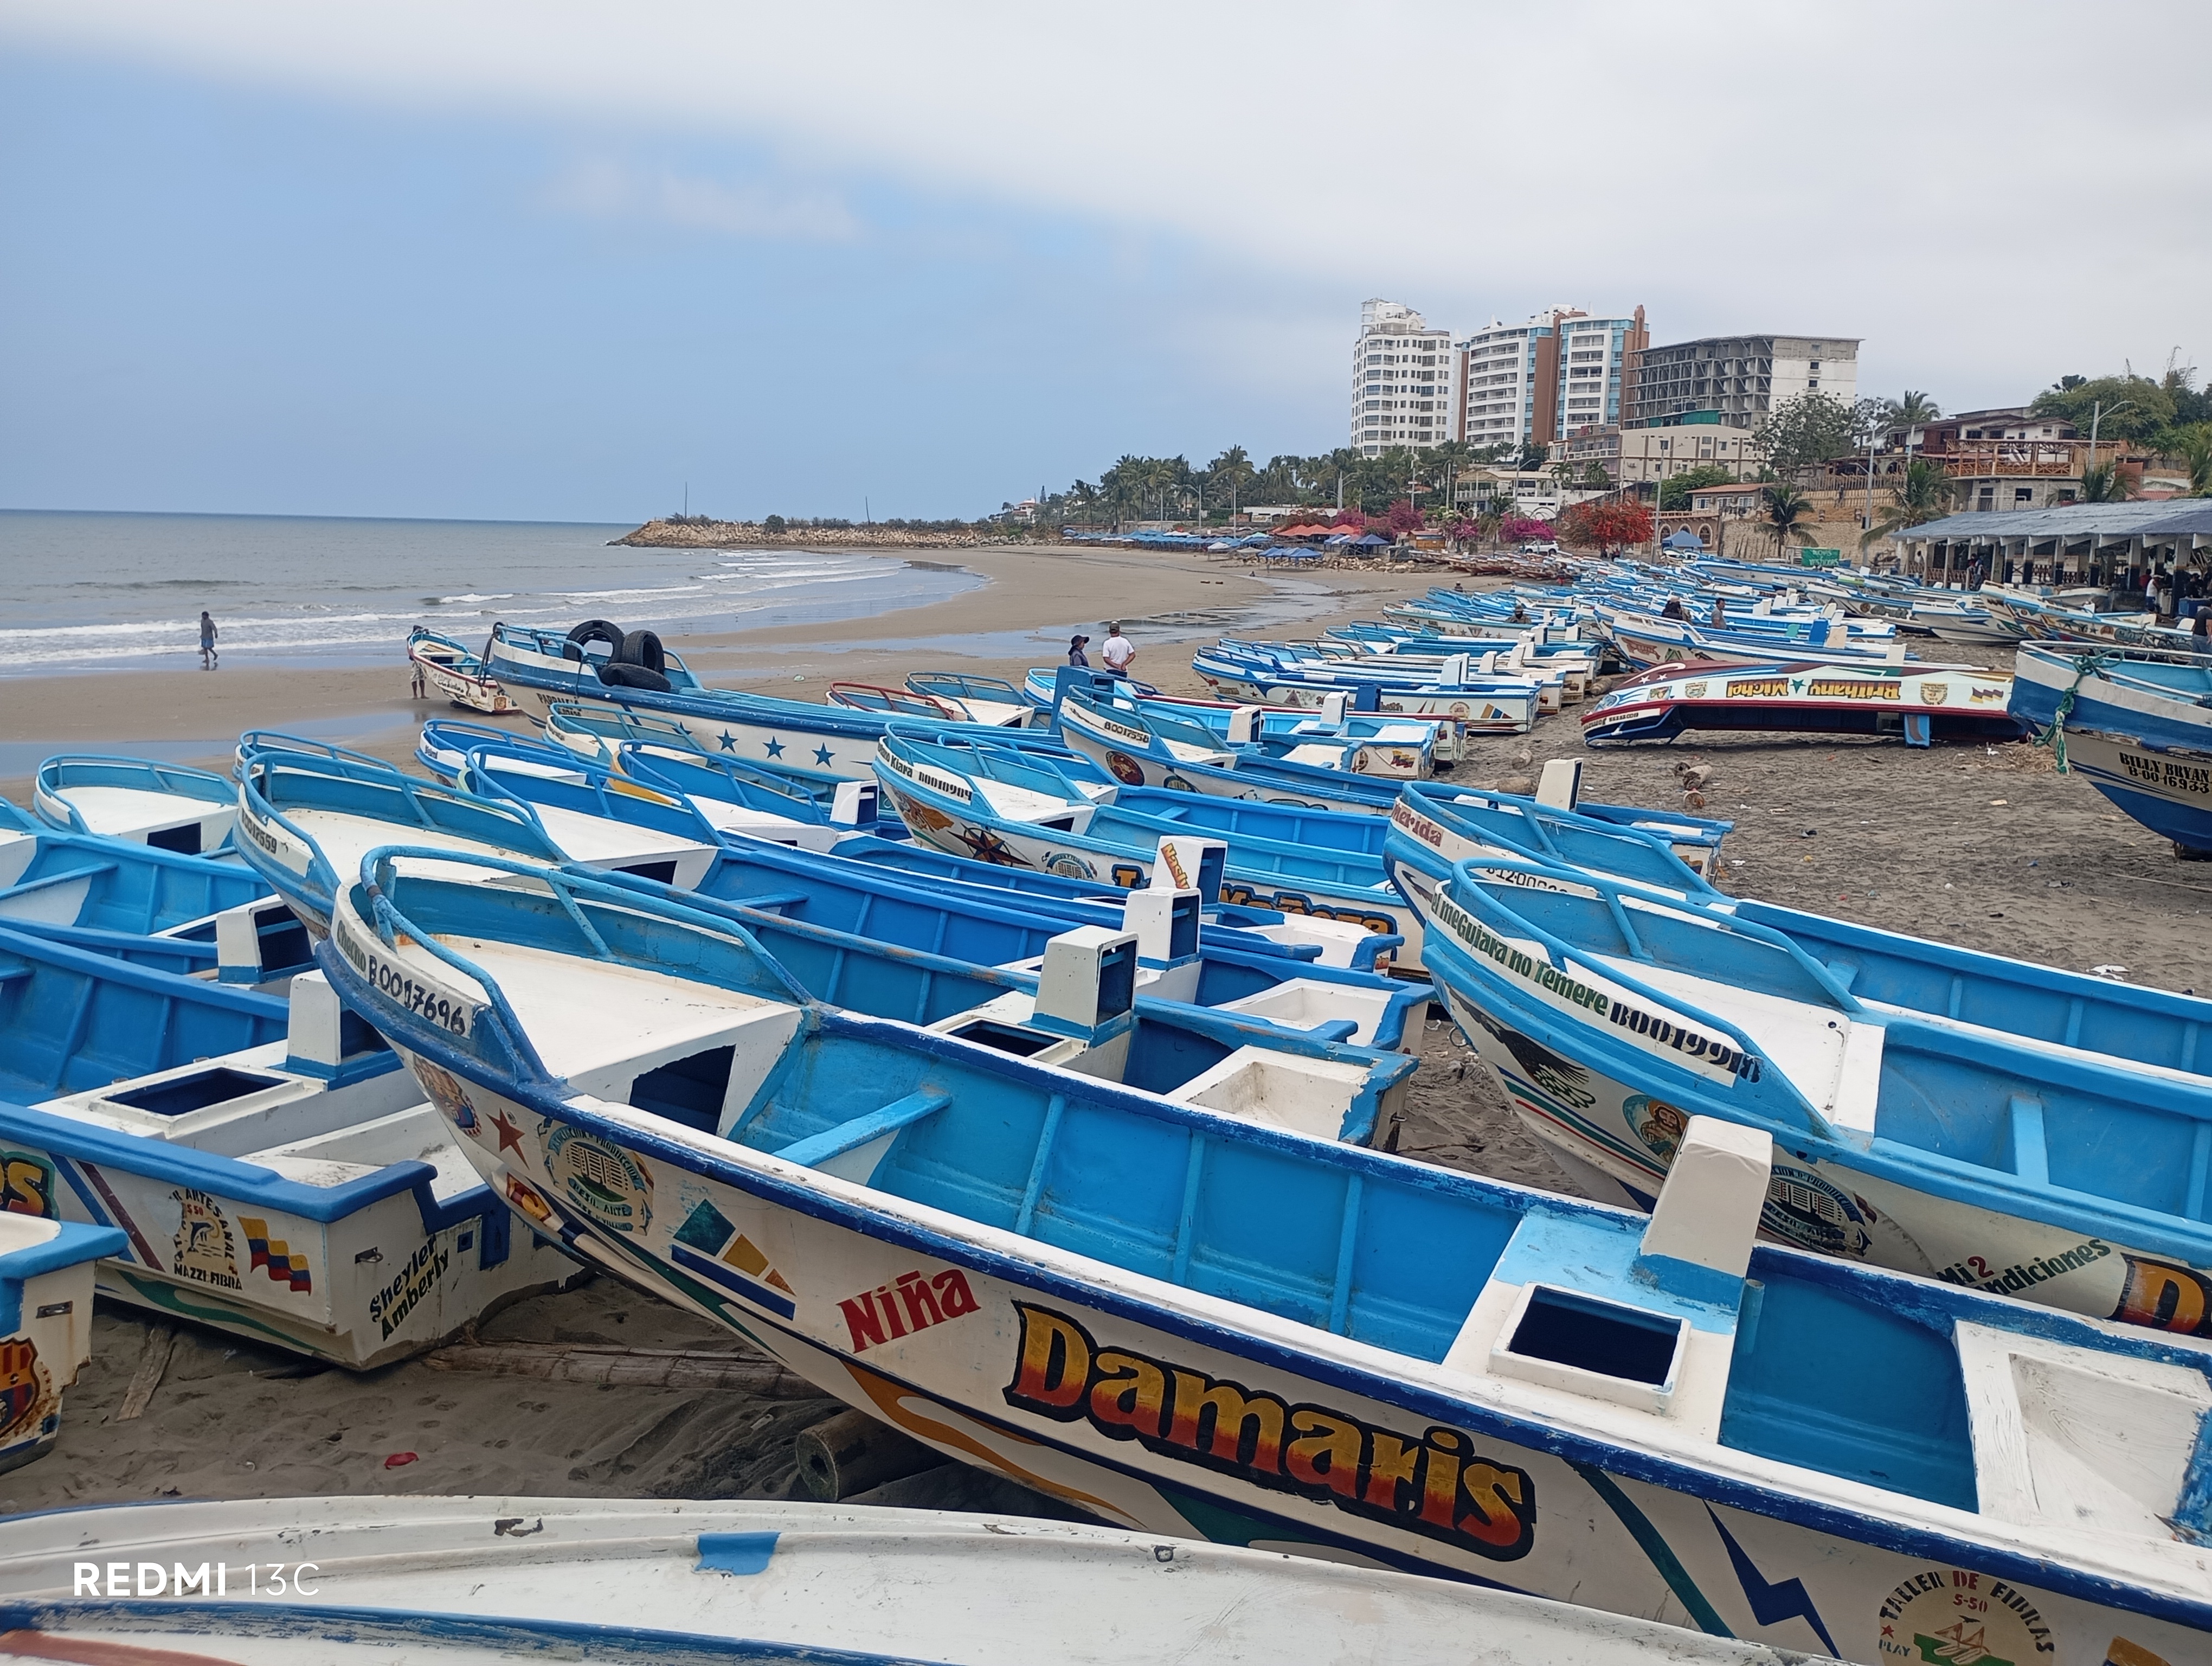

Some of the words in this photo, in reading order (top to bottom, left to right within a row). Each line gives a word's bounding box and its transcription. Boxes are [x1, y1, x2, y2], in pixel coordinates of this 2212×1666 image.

[1726, 678, 1789, 697] Michel
[1104, 721, 1149, 744] B0017558
[2119, 752, 2160, 773] BILLY
[2165, 762, 2209, 783] BRYAN
[1508, 949, 1532, 977] no
[1534, 960, 1609, 1017] Temere
[369, 1234, 437, 1323] Sheyler
[381, 1247, 449, 1342] Amberly
[1967, 1256, 1995, 1278] 2
[1975, 1239, 2111, 1295] ndiciones
[835, 1268, 982, 1354] Niña
[1002, 1300, 1536, 1561] Damaris
[1879, 1571, 1945, 1620] TALLER
[1952, 1571, 1979, 1590] DE
[1989, 1581, 2055, 1652] FIBRAS
